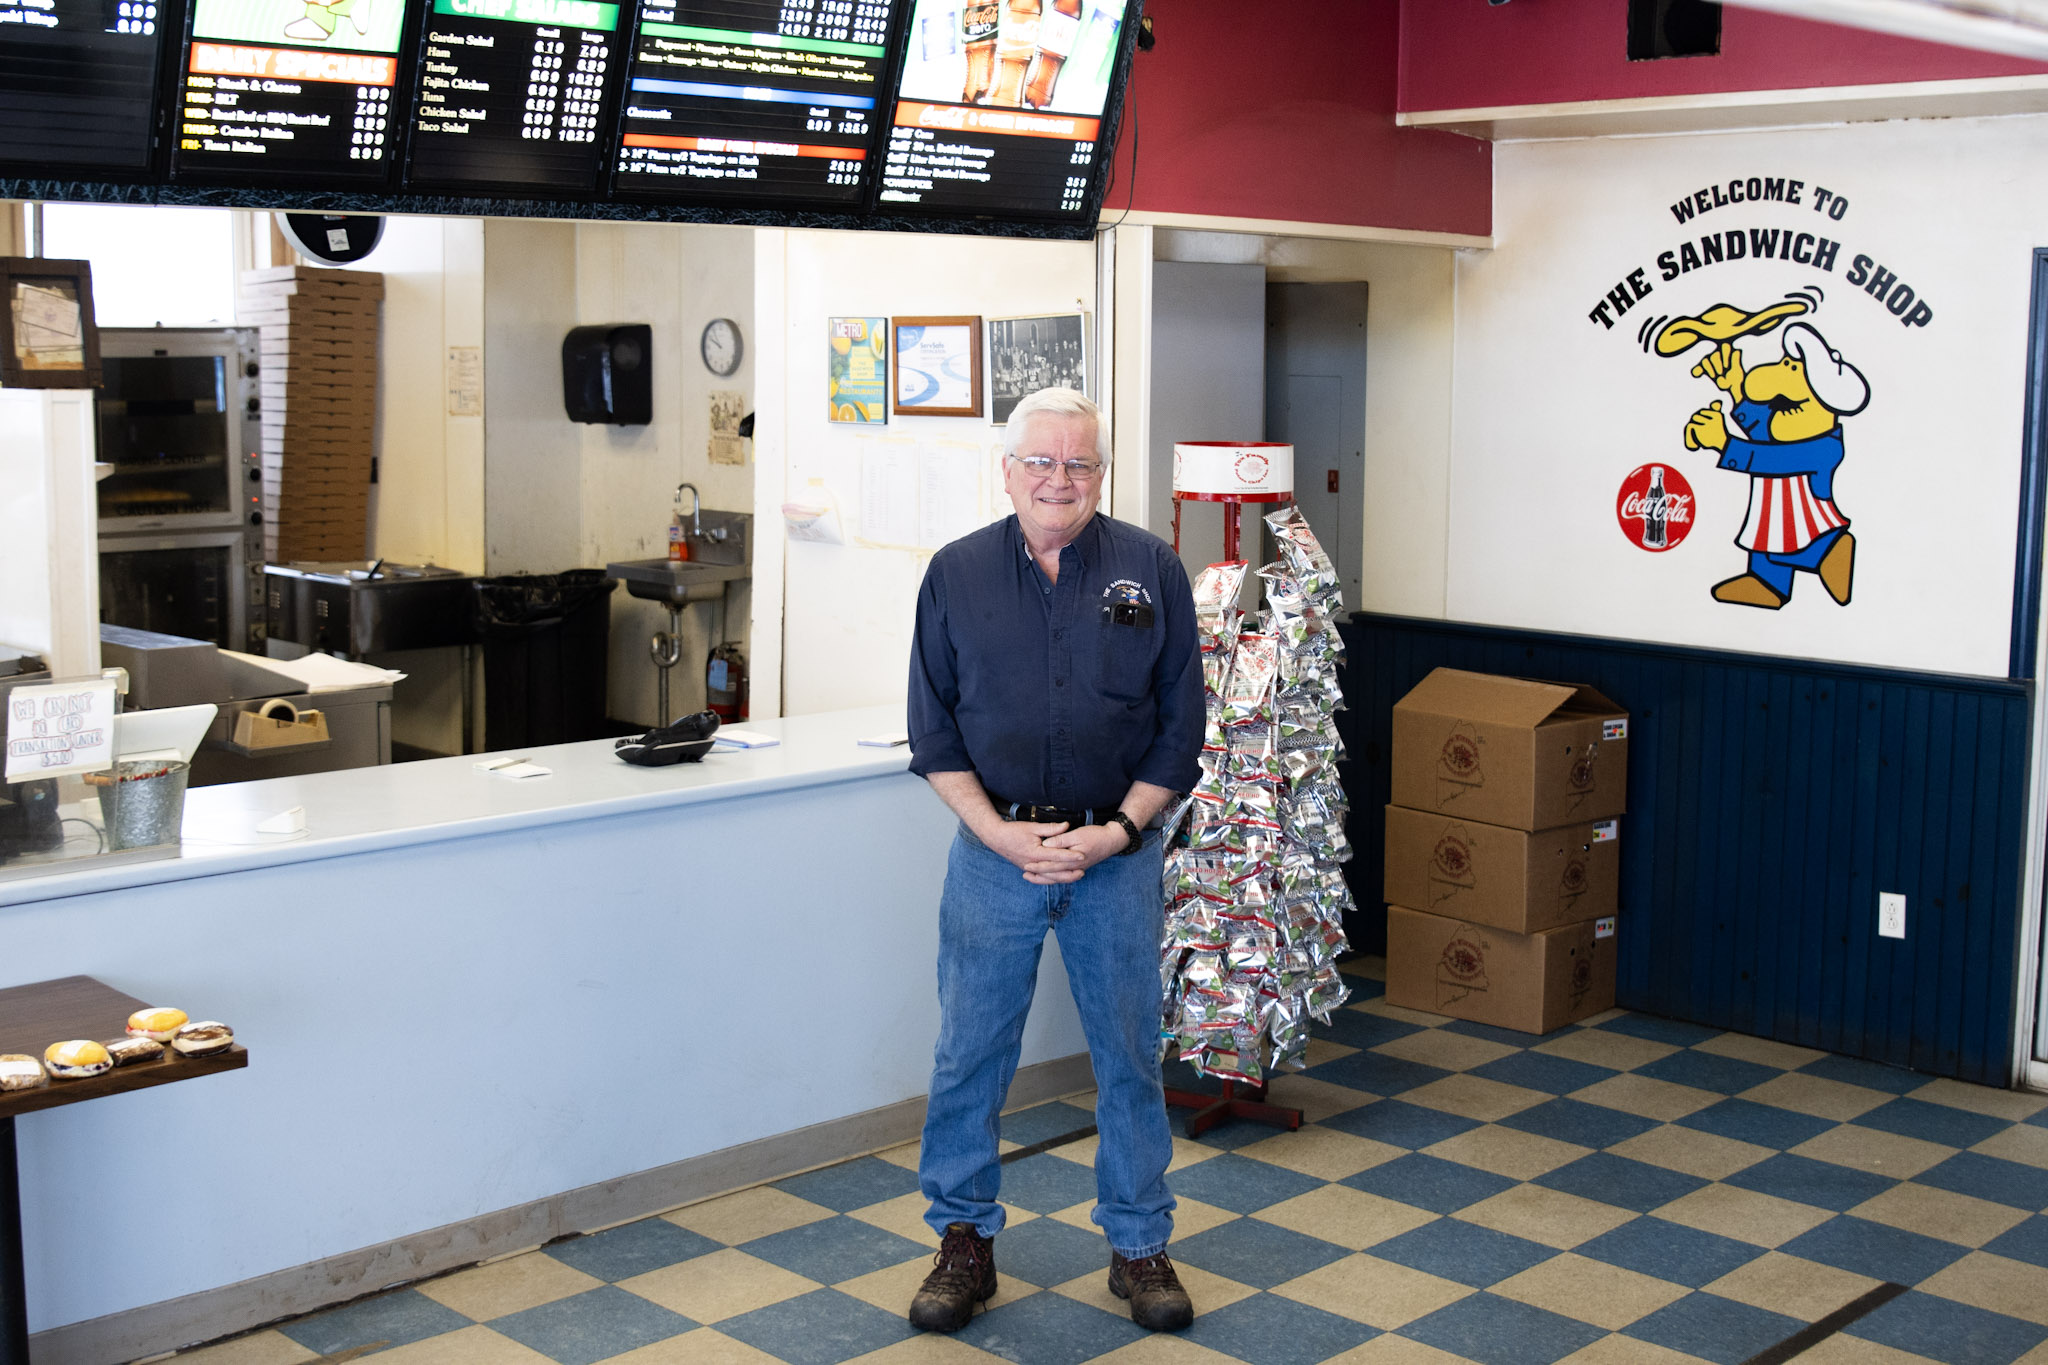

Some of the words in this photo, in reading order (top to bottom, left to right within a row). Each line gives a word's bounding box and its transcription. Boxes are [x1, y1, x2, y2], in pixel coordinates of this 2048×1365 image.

[516, 0, 600, 26] SALADS
[429, 31, 465, 45] Garden
[465, 34, 494, 47] Salad
[427, 46, 451, 58] Ham
[198, 45, 272, 74] DAILY
[275, 50, 389, 83] SPECIALS
[426, 61, 459, 75] Turkey
[423, 76, 450, 89] Fajita
[451, 78, 490, 91] Chicken
[215, 93, 239, 105] BLT
[422, 91, 445, 102] Tuna
[420, 106, 457, 118] Chicken
[458, 108, 487, 120] Salad
[418, 120, 441, 132] Taco
[442, 122, 470, 134] Salad
[1670, 177, 1804, 225] WELCOME
[1813, 186, 1849, 221] TO
[1588, 267, 1653, 331] THE
[1657, 228, 1841, 281] SANDWICH
[1846, 254, 1933, 328] SHOP
[836, 323, 862, 338] METRO
[920, 341, 945, 349] ServSafe
[1621, 491, 1691, 523] Coca-Cola
[1103, 587, 1111, 598] THE
[1110, 579, 1141, 589] SANDWICH
[1141, 588, 1152, 604] SHOP
